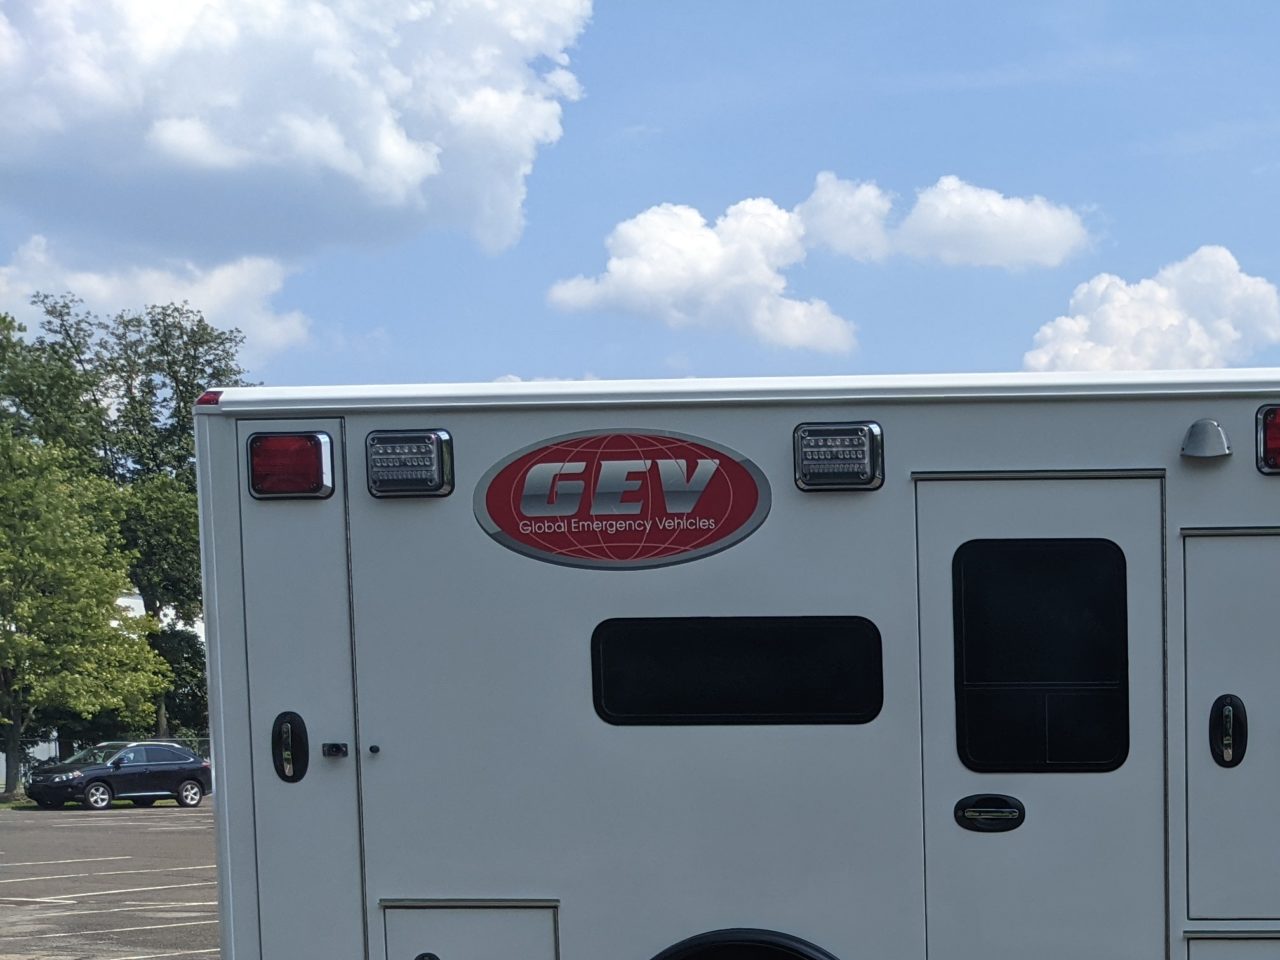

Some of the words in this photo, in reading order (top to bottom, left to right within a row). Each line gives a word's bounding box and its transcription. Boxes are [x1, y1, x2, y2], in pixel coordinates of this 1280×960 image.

[519, 458, 720, 517] GEV
[519, 518, 568, 534] Global
[571, 517, 653, 534] Emergency
[656, 515, 716, 531] Vehicles
